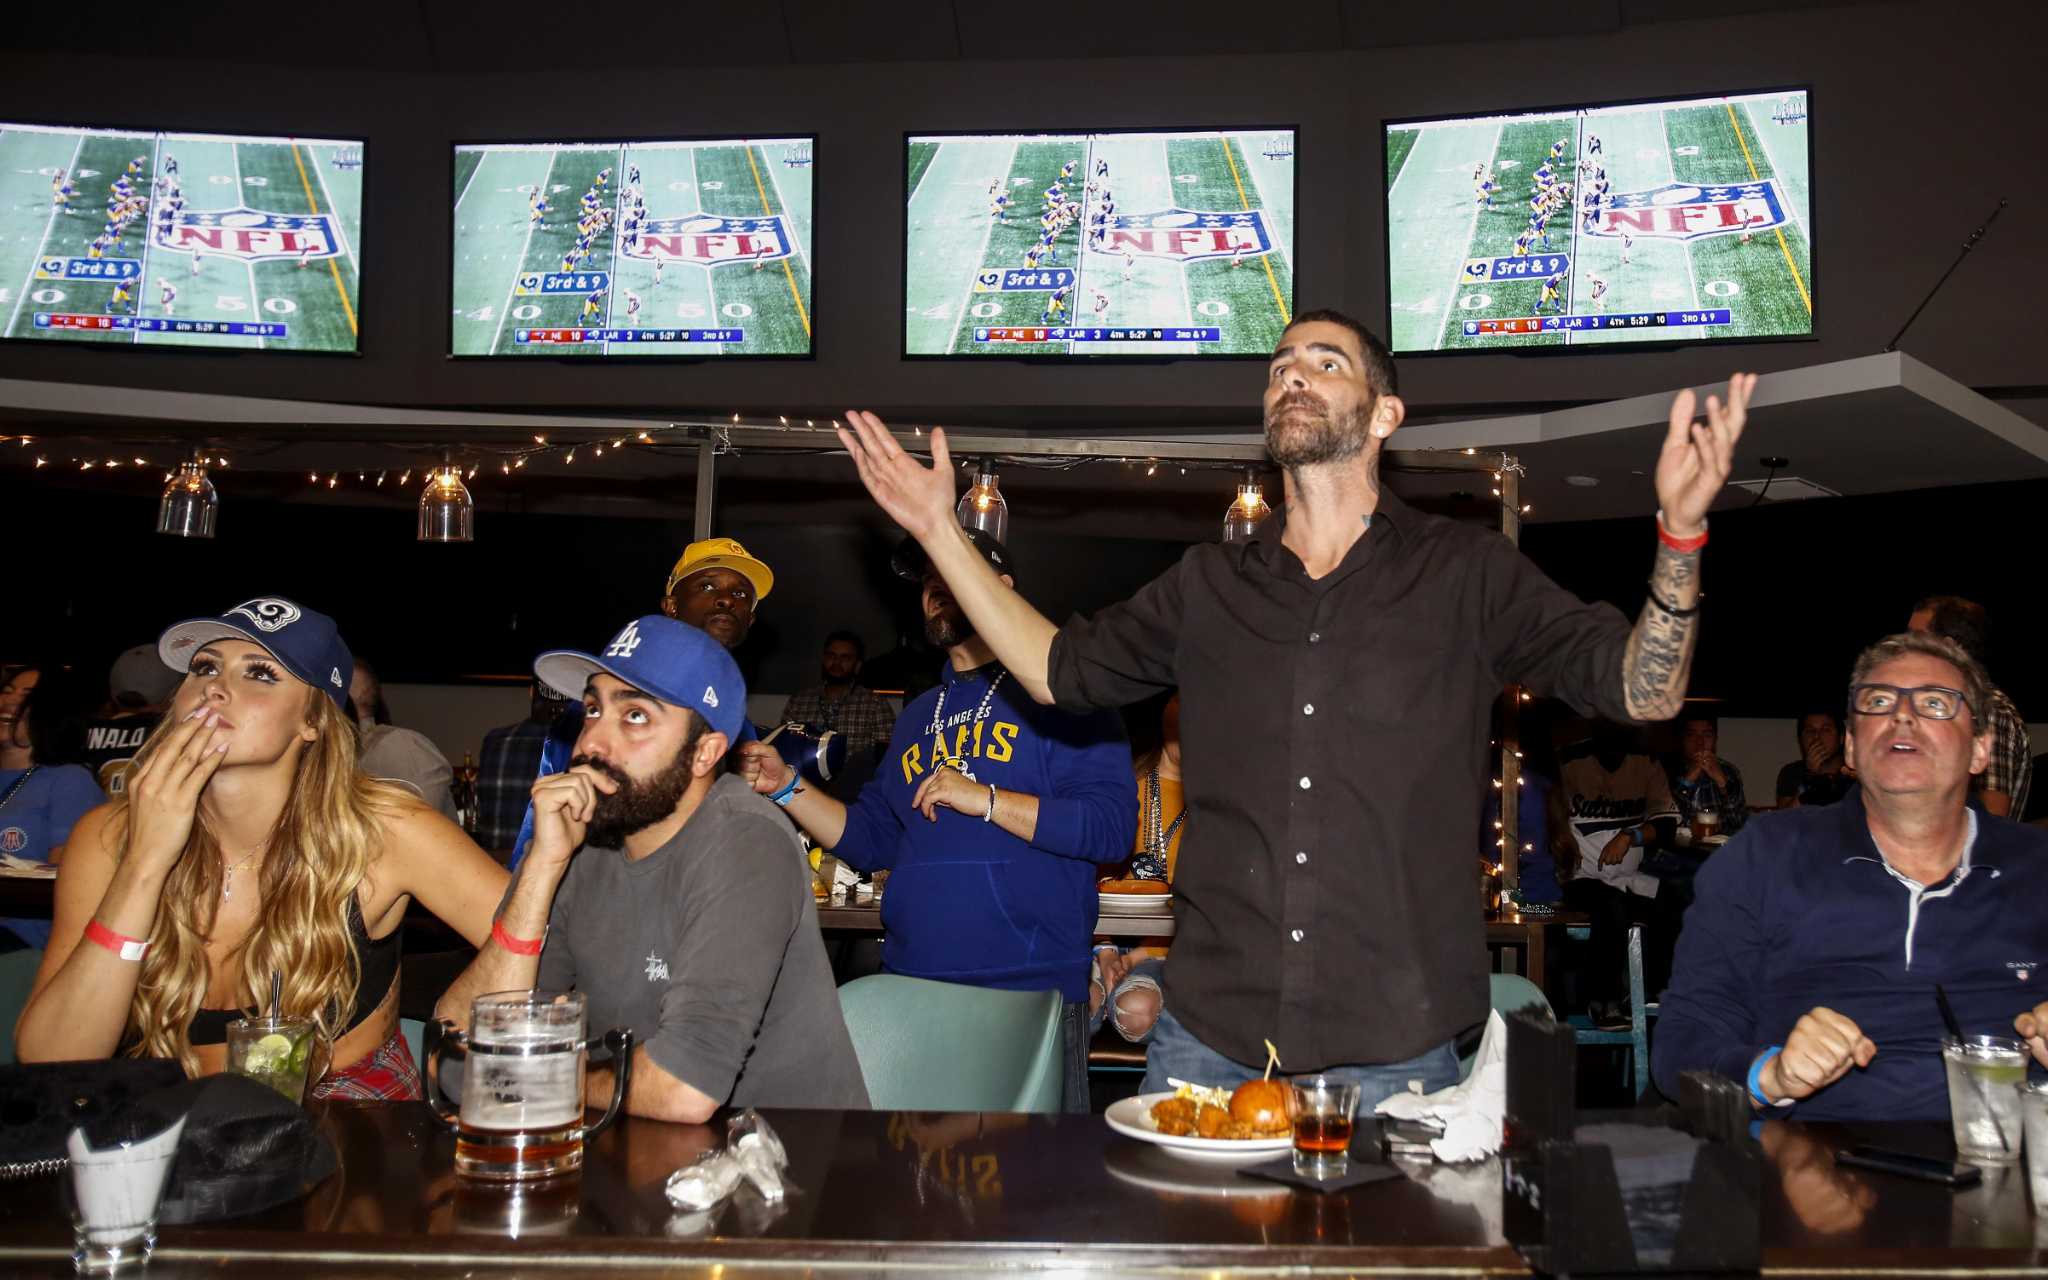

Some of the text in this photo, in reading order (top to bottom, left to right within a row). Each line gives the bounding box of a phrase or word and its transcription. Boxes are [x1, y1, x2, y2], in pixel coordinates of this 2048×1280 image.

[1603, 203, 1764, 232] NFL
[179, 227, 319, 252] NFL
[642, 234, 774, 258] NFL
[1109, 229, 1253, 255] NFL
[71, 261, 133, 276] 3rd & 9
[1497, 258, 1559, 275] 3rd & 9
[546, 275, 601, 289] 3rd & 9
[1008, 273, 1066, 286] 3rd & 9
[1504, 321, 1516, 330] NE
[1527, 320, 1538, 330] 10
[1565, 318, 1582, 327] LAR
[1592, 318, 1599, 327] 3
[1630, 316, 1648, 325] 5:29
[1656, 315, 1665, 324] 10
[607, 620, 641, 657] LA
[947, 705, 992, 729] ANGEES
[901, 719, 1019, 785] RAMS
